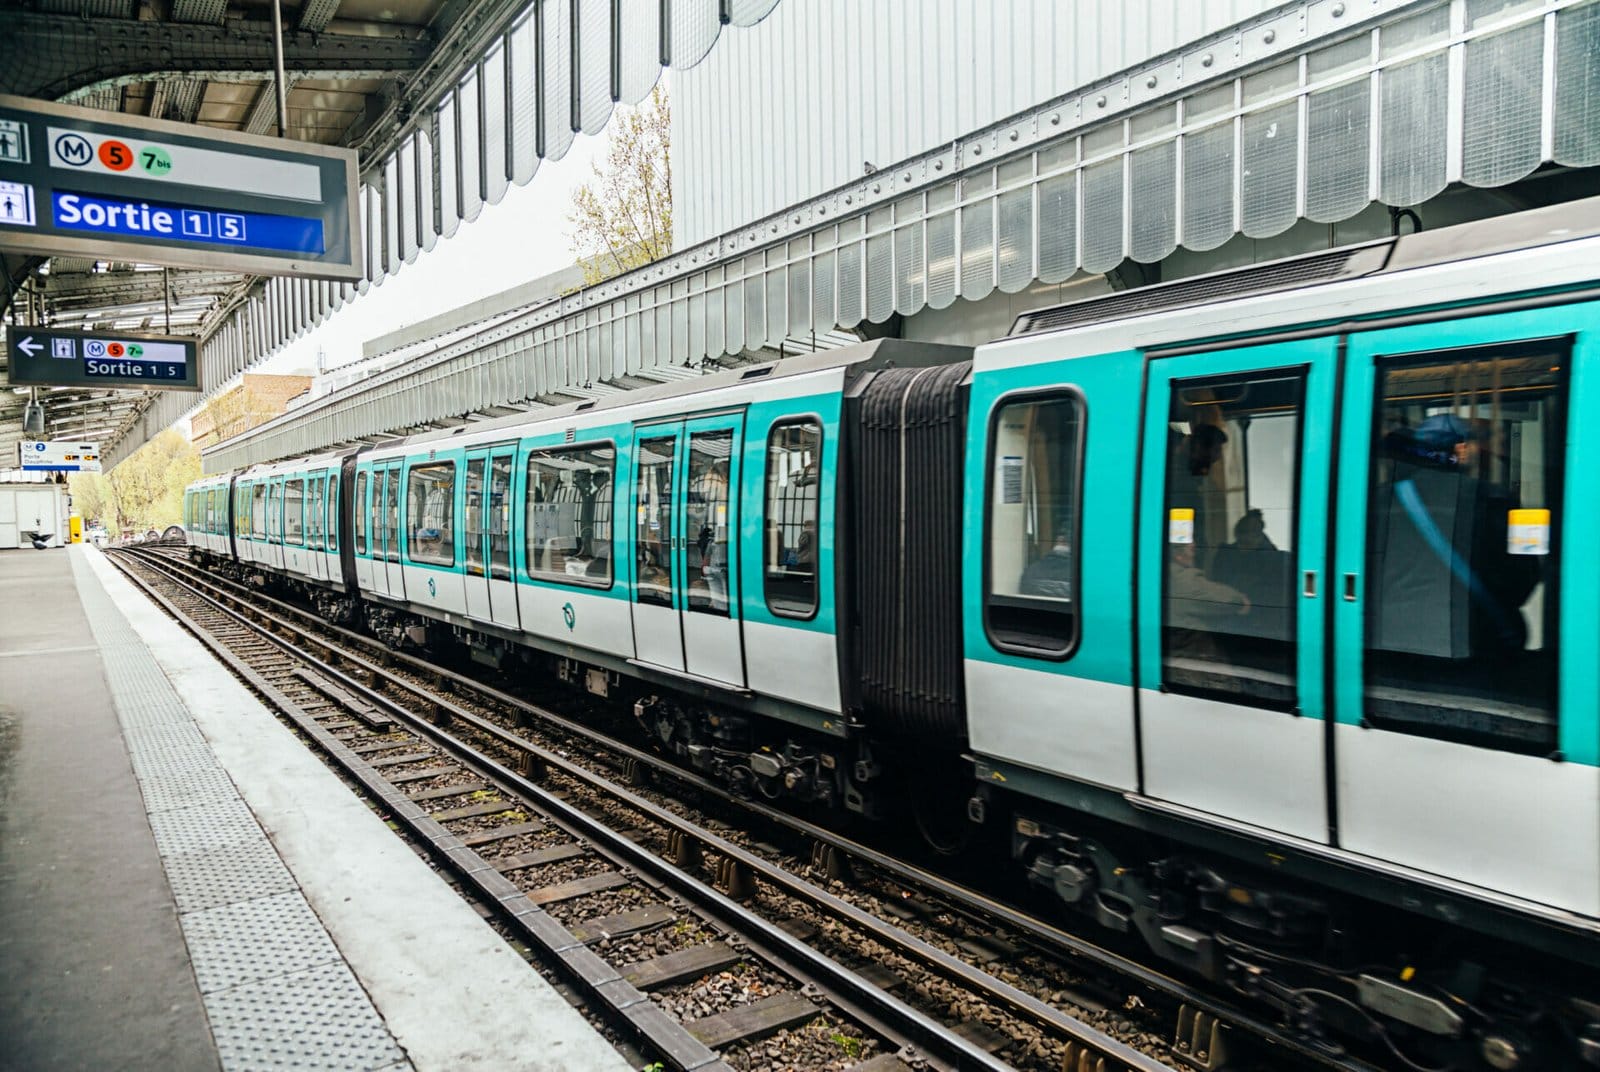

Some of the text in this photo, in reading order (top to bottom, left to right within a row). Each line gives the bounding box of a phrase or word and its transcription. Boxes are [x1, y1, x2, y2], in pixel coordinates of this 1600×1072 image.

[64, 141, 85, 159] M
[110, 147, 123, 164] 5
[58, 195, 239, 237] Sortie 1 5
[113, 346, 119, 354] 5
[87, 360, 176, 376] Sortie 1 5
